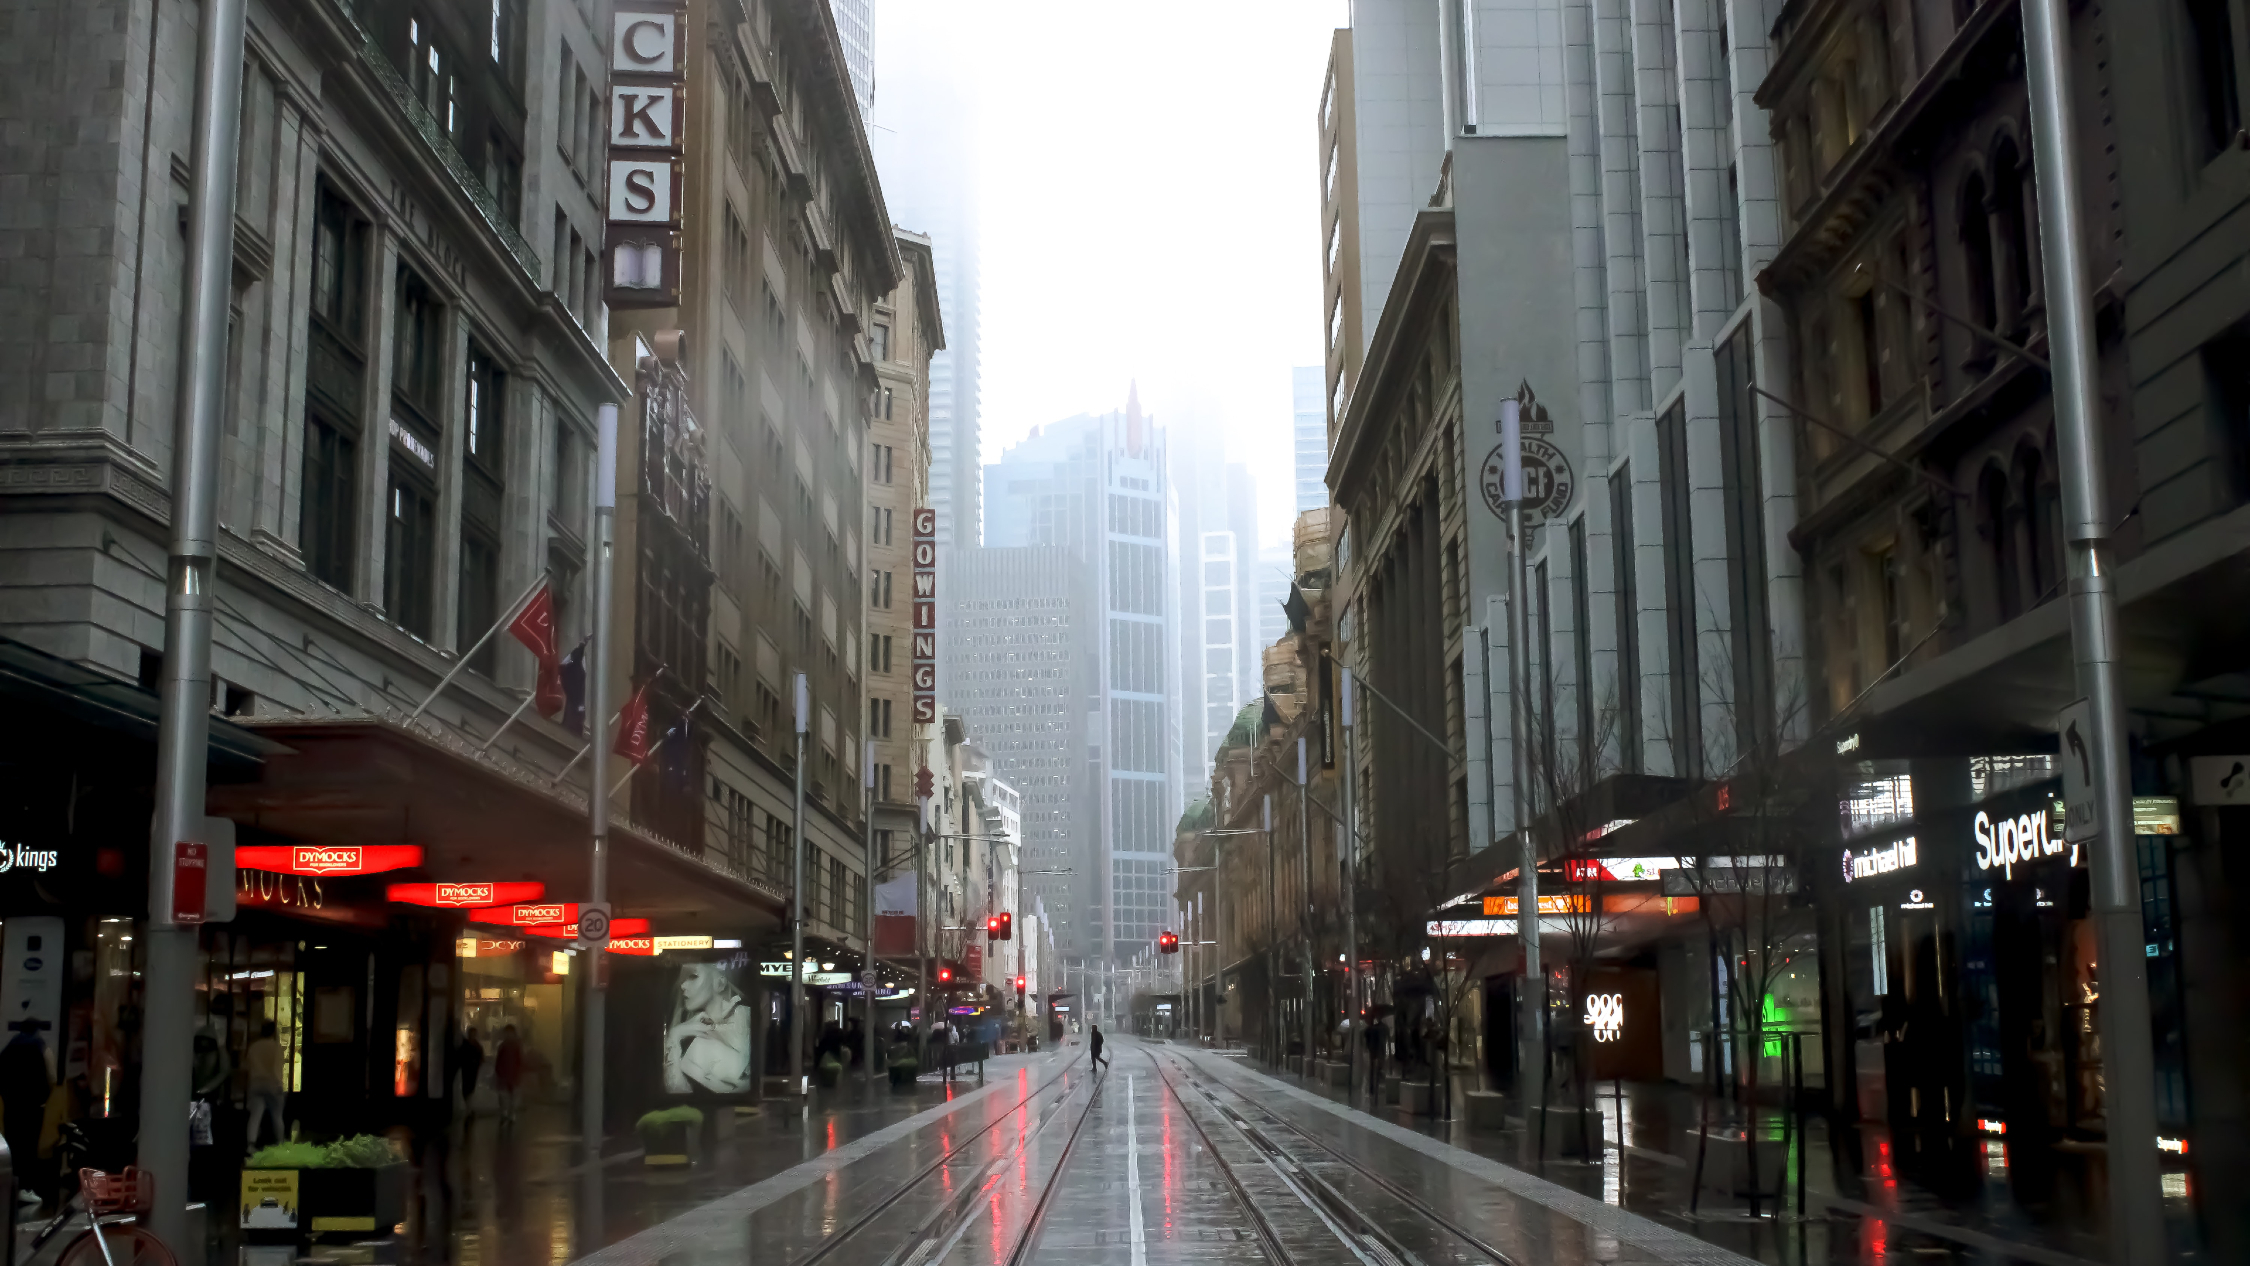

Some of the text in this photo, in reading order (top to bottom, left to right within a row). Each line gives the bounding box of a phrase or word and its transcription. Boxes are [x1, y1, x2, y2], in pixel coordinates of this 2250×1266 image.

[915, 512, 933, 720] GOWINGS
[2068, 801, 2095, 828] ONLY
[16, 843, 58, 872] kings
[300, 852, 356, 862] DYMOCKS
[1854, 836, 1917, 879] michael hill
[1576, 867, 1598, 878] ATM
[441, 888, 488, 896] DYMOCKS
[1507, 900, 1553, 910] baest
[518, 909, 560, 917] DYMOCKS
[585, 918, 604, 933] 20
[657, 939, 710, 948] STATIONERY
